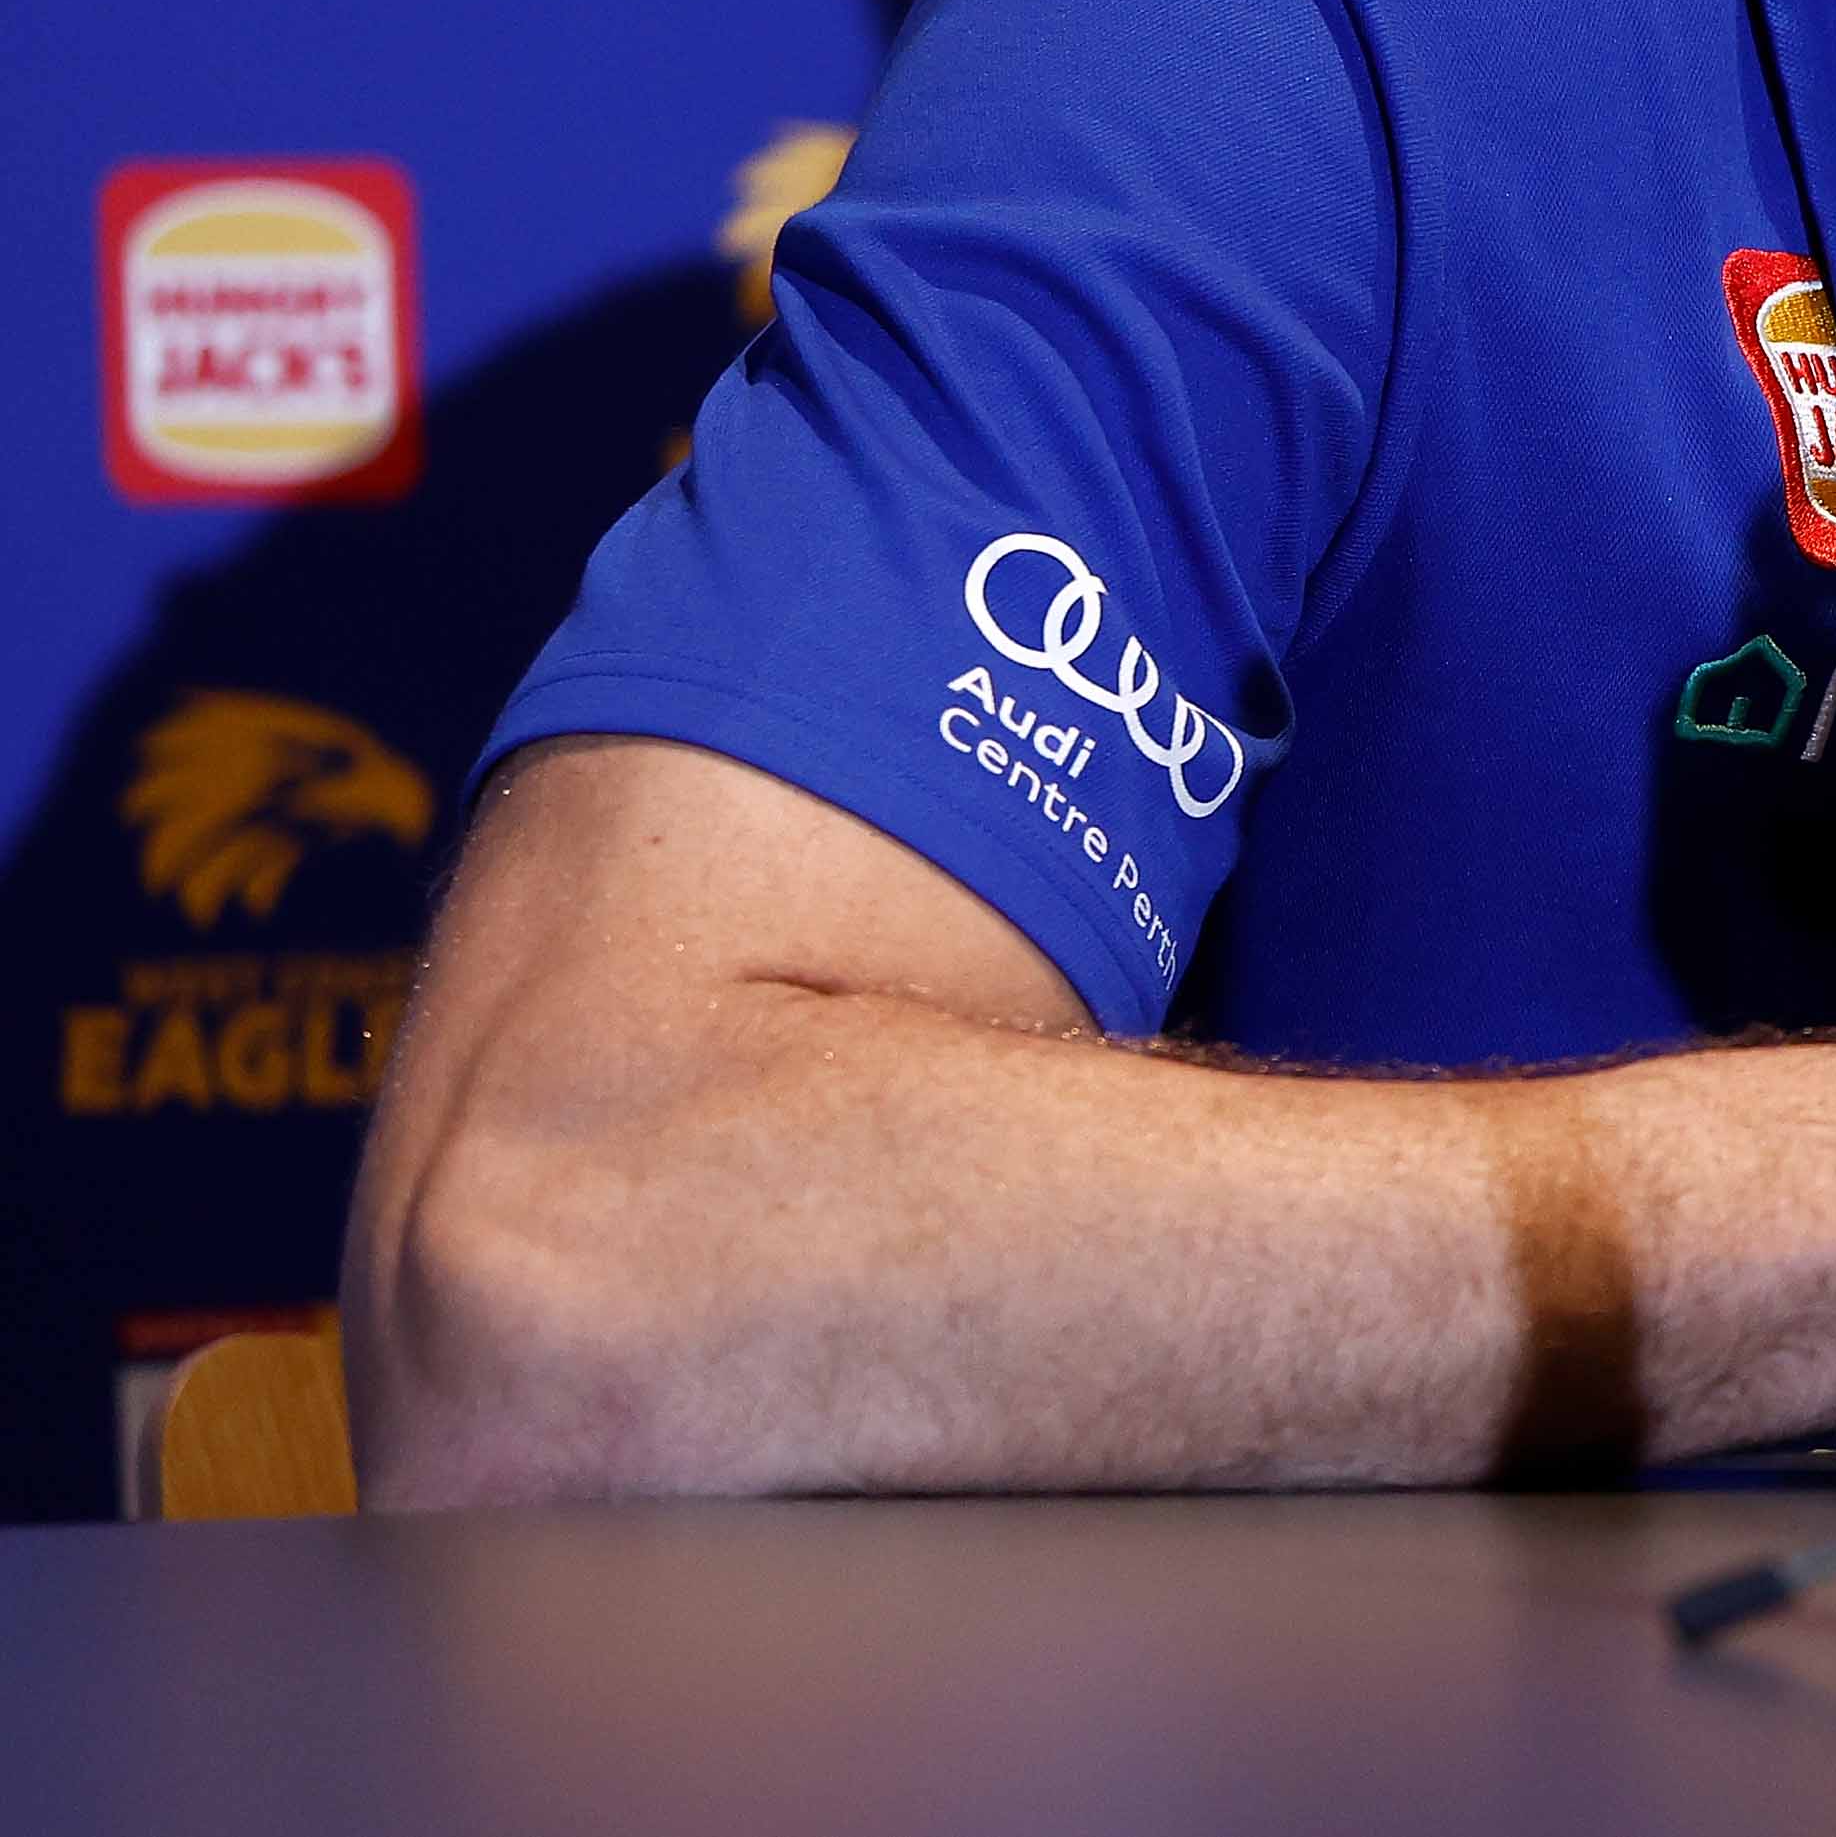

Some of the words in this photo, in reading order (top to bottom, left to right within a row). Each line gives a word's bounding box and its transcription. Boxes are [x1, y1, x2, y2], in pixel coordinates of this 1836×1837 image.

[946, 666, 1098, 780] Audi
[938, 707, 1110, 863] Centre
[1112, 854, 1177, 991] Perth
[61, 1001, 398, 1115] EAGL
